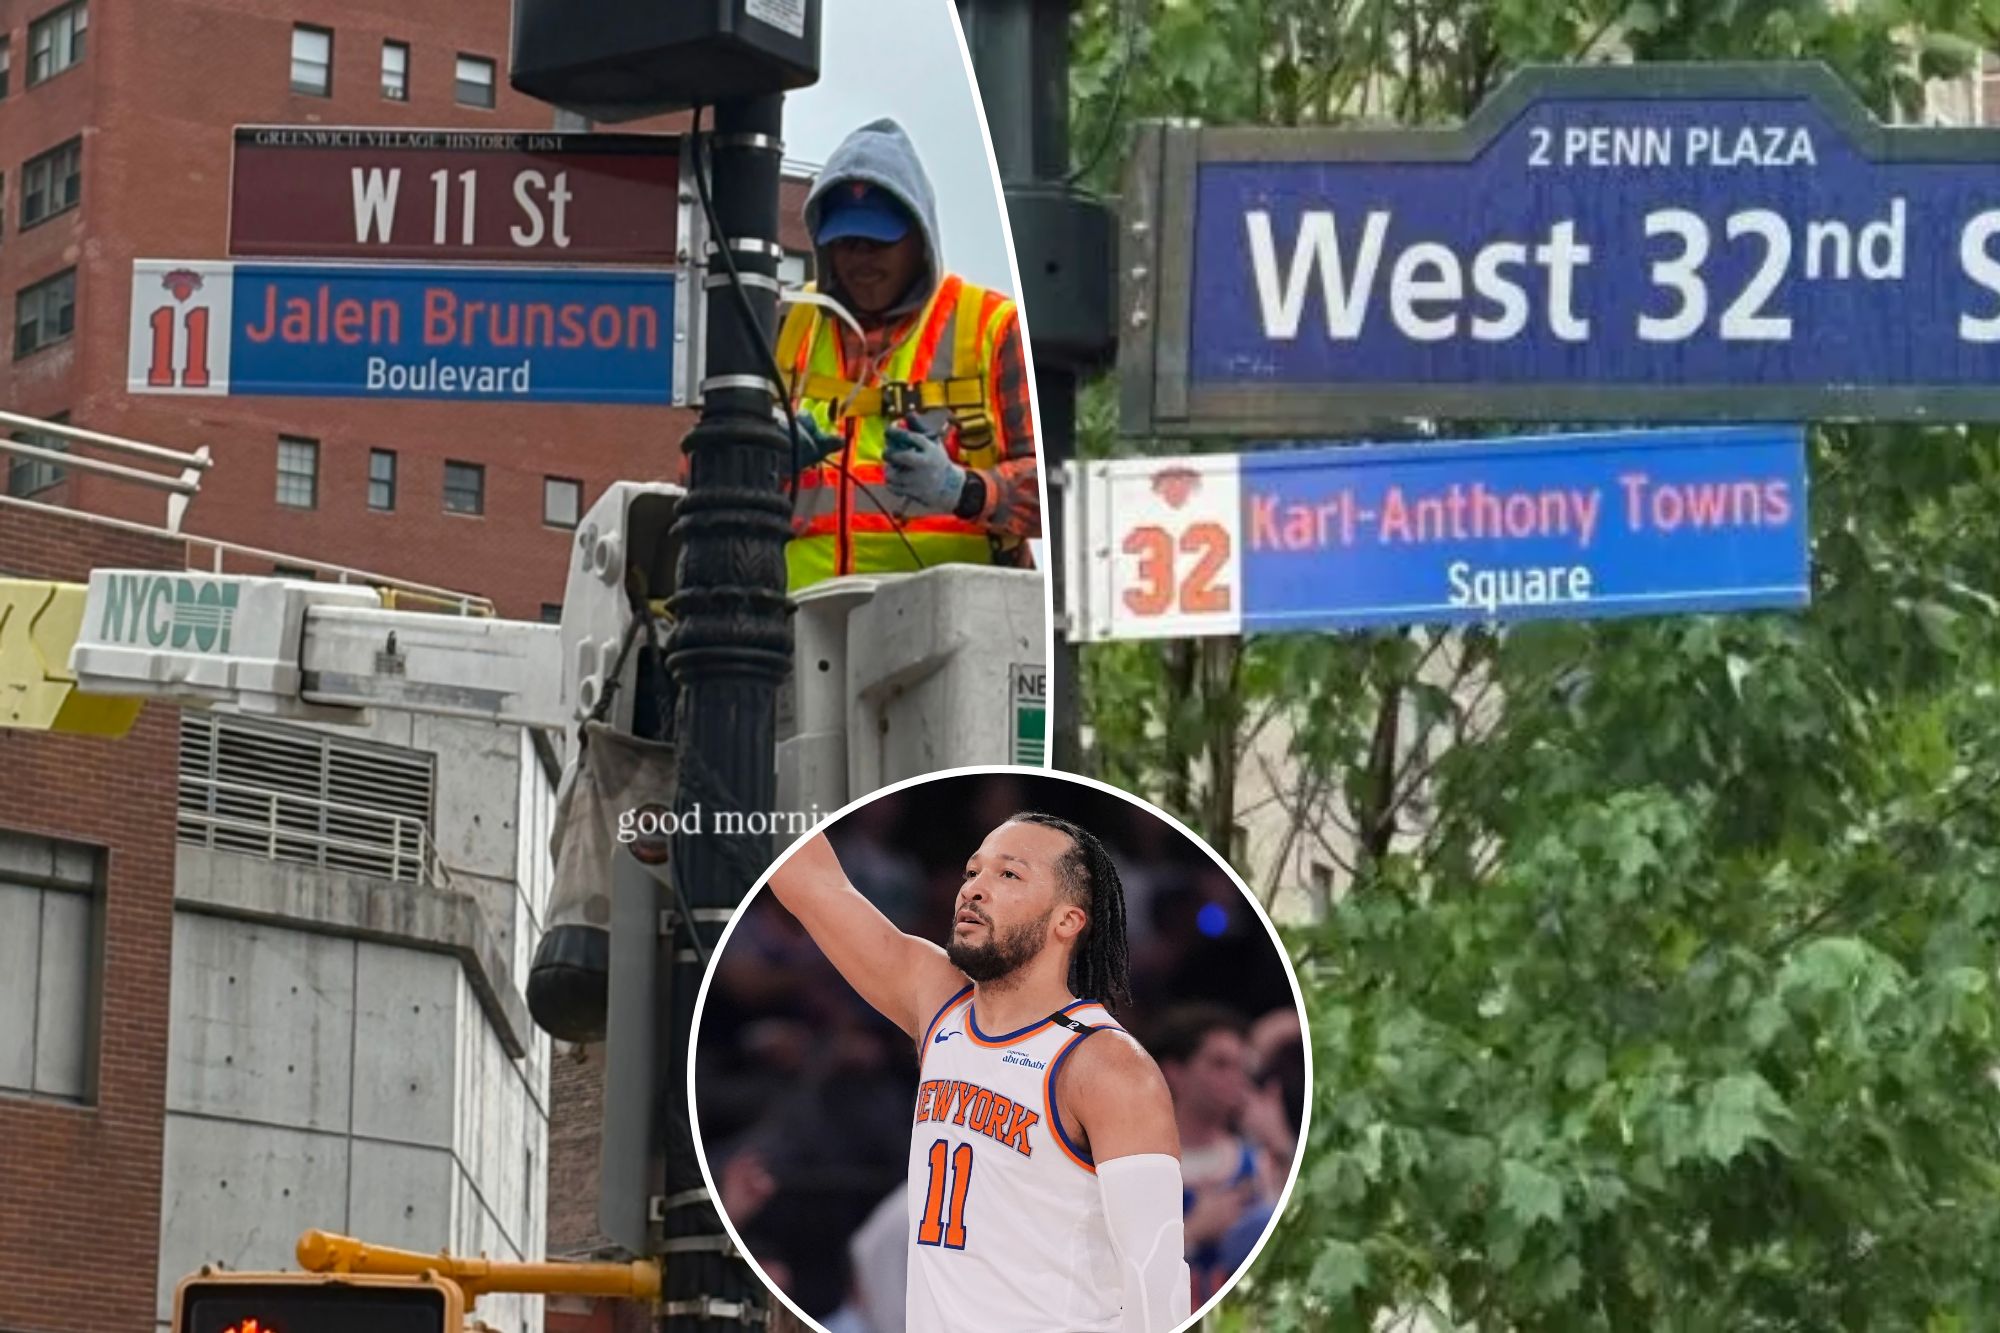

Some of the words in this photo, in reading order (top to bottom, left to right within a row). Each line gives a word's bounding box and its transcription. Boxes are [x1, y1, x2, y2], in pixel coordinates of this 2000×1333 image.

[255, 131, 361, 147] GREENWICH
[366, 132, 437, 148] VILLAGE
[445, 134, 521, 149] HISTORIC
[1528, 127, 1551, 166] 2
[1565, 127, 1671, 166] PENN
[1686, 127, 1817, 166] PLAZA
[351, 167, 401, 243] W
[430, 169, 476, 245] 11
[510, 169, 573, 247] St
[1245, 211, 1591, 341] West
[1637, 198, 1906, 341] 32nd
[148, 306, 209, 388] 11
[246, 284, 401, 344] Jalen
[424, 288, 657, 348] Brunson
[366, 356, 530, 393] Boulevard
[1251, 482, 1600, 551] Karl-Anthony
[1618, 471, 1791, 532] Towns
[1121, 521, 1231, 617] 32
[1448, 560, 1592, 613] Square
[1020, 1058, 1046, 1070] dhabi
[917, 1138, 974, 1250] 11
